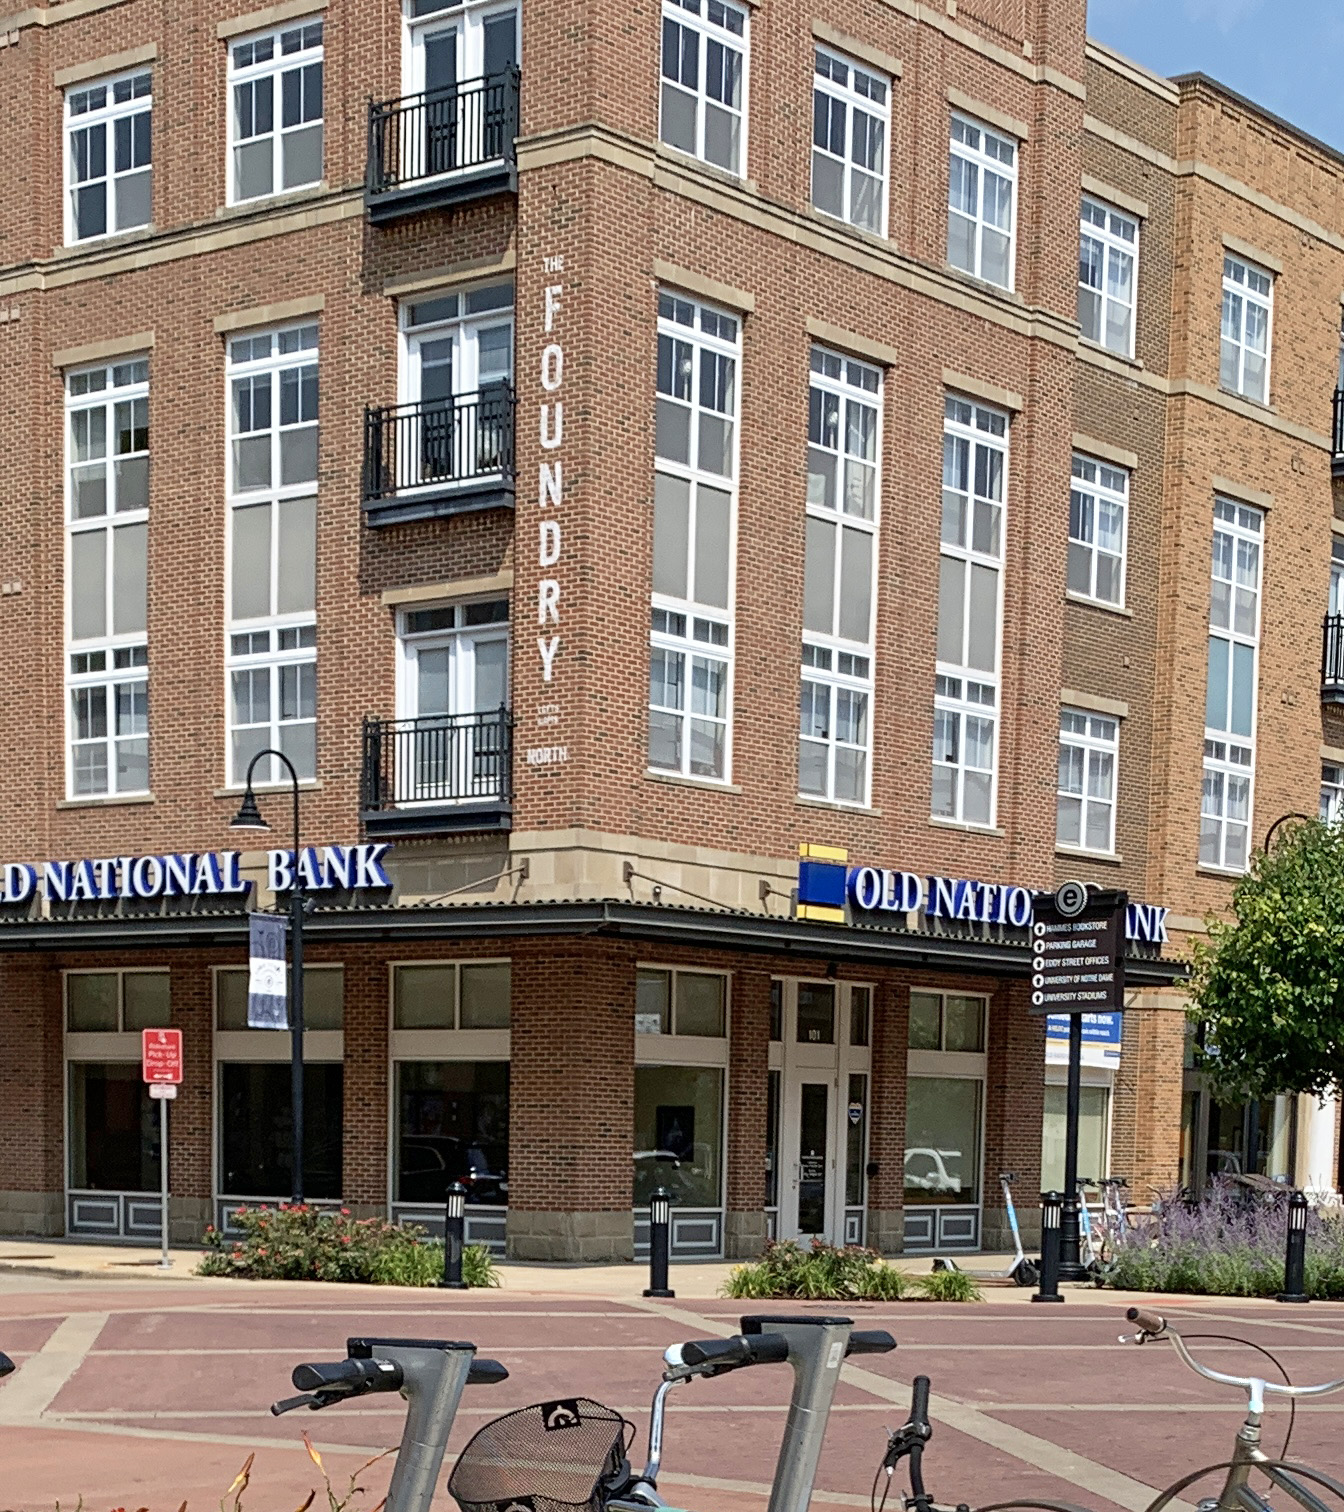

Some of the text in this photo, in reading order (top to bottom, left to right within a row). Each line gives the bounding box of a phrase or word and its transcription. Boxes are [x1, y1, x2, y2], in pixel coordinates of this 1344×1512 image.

[543, 254, 565, 273] THE
[537, 284, 564, 683] FOUNDRY
[527, 746, 568, 765] NORTH
[42, 851, 250, 901] NATIONAL
[266, 843, 392, 891] BANK
[851, 866, 924, 913] OLD
[928, 875, 1034, 928] NATIO
[1072, 920, 1107, 932] BOOKSTORE
[1046, 938, 1096, 950] PARKING GARAGE
[1045, 955, 1109, 968] EDDY STREET OFFICES
[1044, 973, 1113, 985] UNIVERSITY OF NOTRE DAME
[1044, 990, 1107, 1002] UNIVERSITY STADIUMS
[808, 1029, 821, 1041] 101
